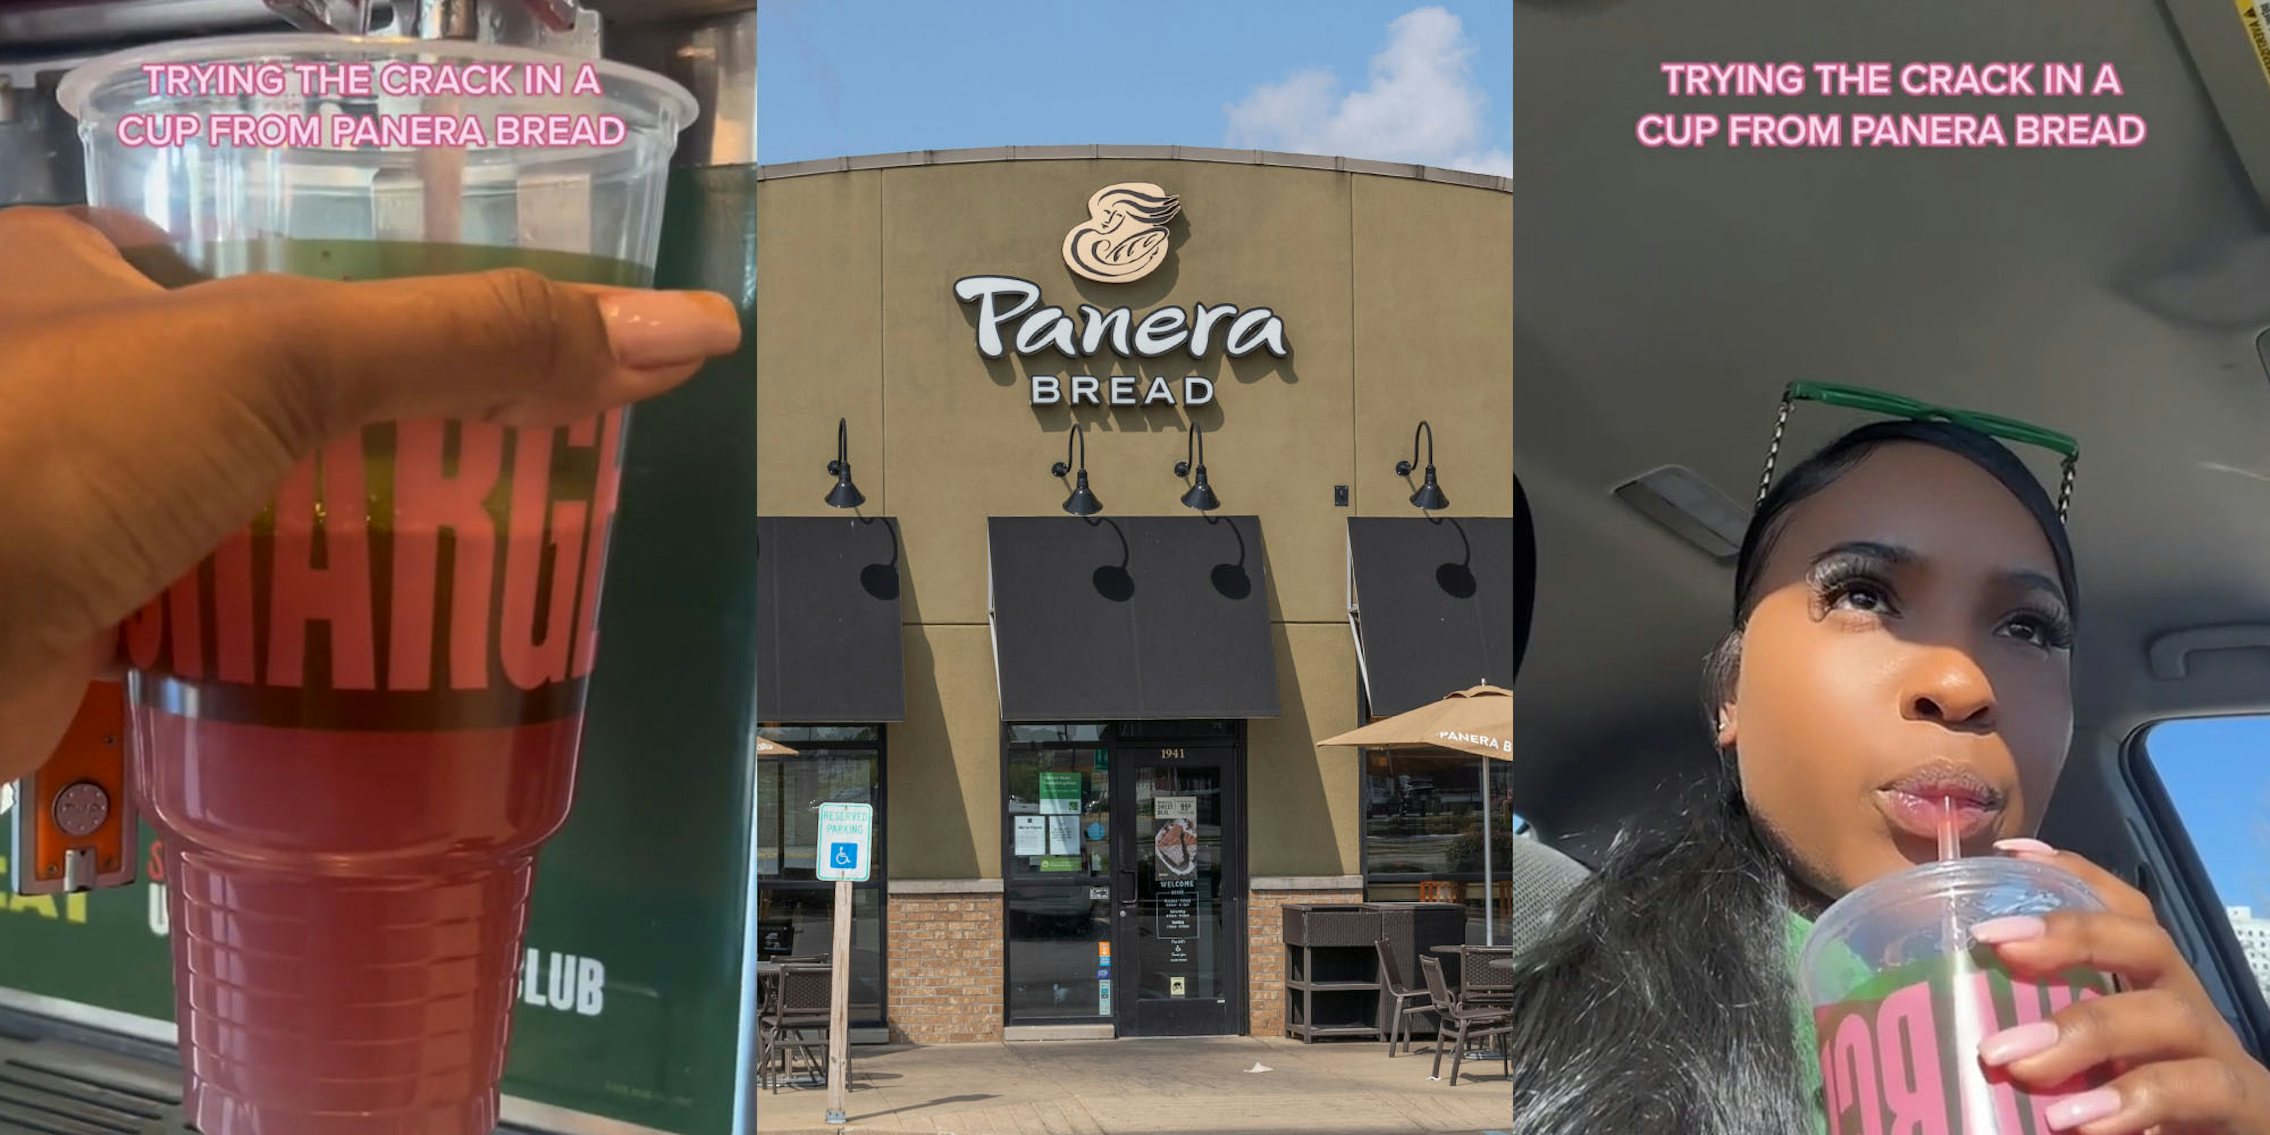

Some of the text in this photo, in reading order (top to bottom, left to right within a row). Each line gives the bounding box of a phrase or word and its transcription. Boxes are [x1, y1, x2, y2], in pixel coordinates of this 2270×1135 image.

[954, 275, 1289, 358] Panera
[1030, 375, 1214, 405] BREAD
[1440, 731, 1499, 750] PANERA
[1161, 748, 1184, 759] 1941
[823, 811, 867, 822] RESERVED
[826, 824, 863, 835] PARKING
[1160, 880, 1194, 888] WELCOME
[517, 947, 606, 1016] LUB
